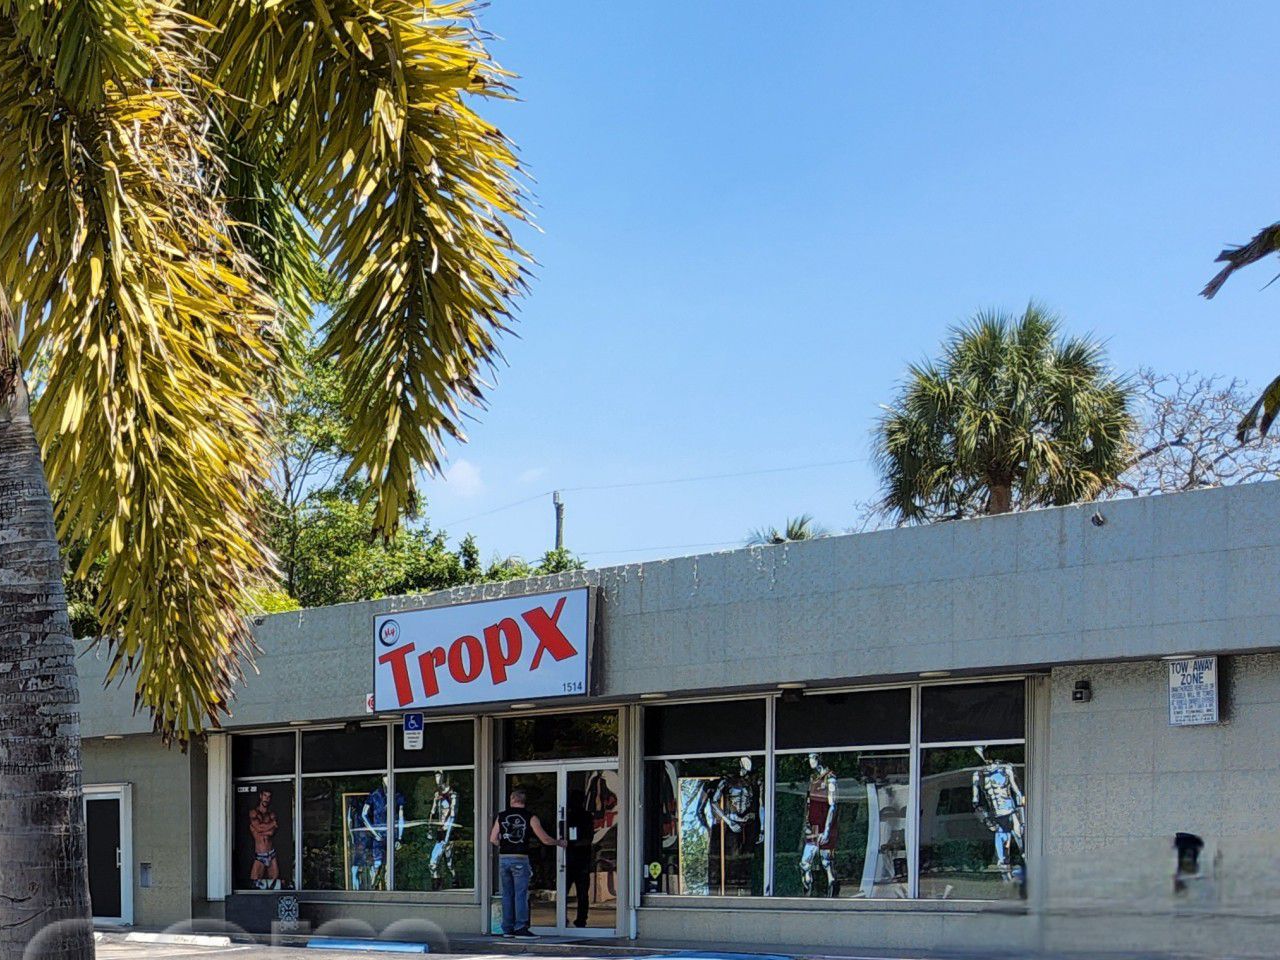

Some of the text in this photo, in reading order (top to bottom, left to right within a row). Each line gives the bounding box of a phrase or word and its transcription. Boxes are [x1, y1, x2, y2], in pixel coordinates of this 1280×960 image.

[1171, 659, 1214, 674] TOW AWAY
[1180, 672, 1204, 685] ZONE
[562, 682, 583, 693] 1514
